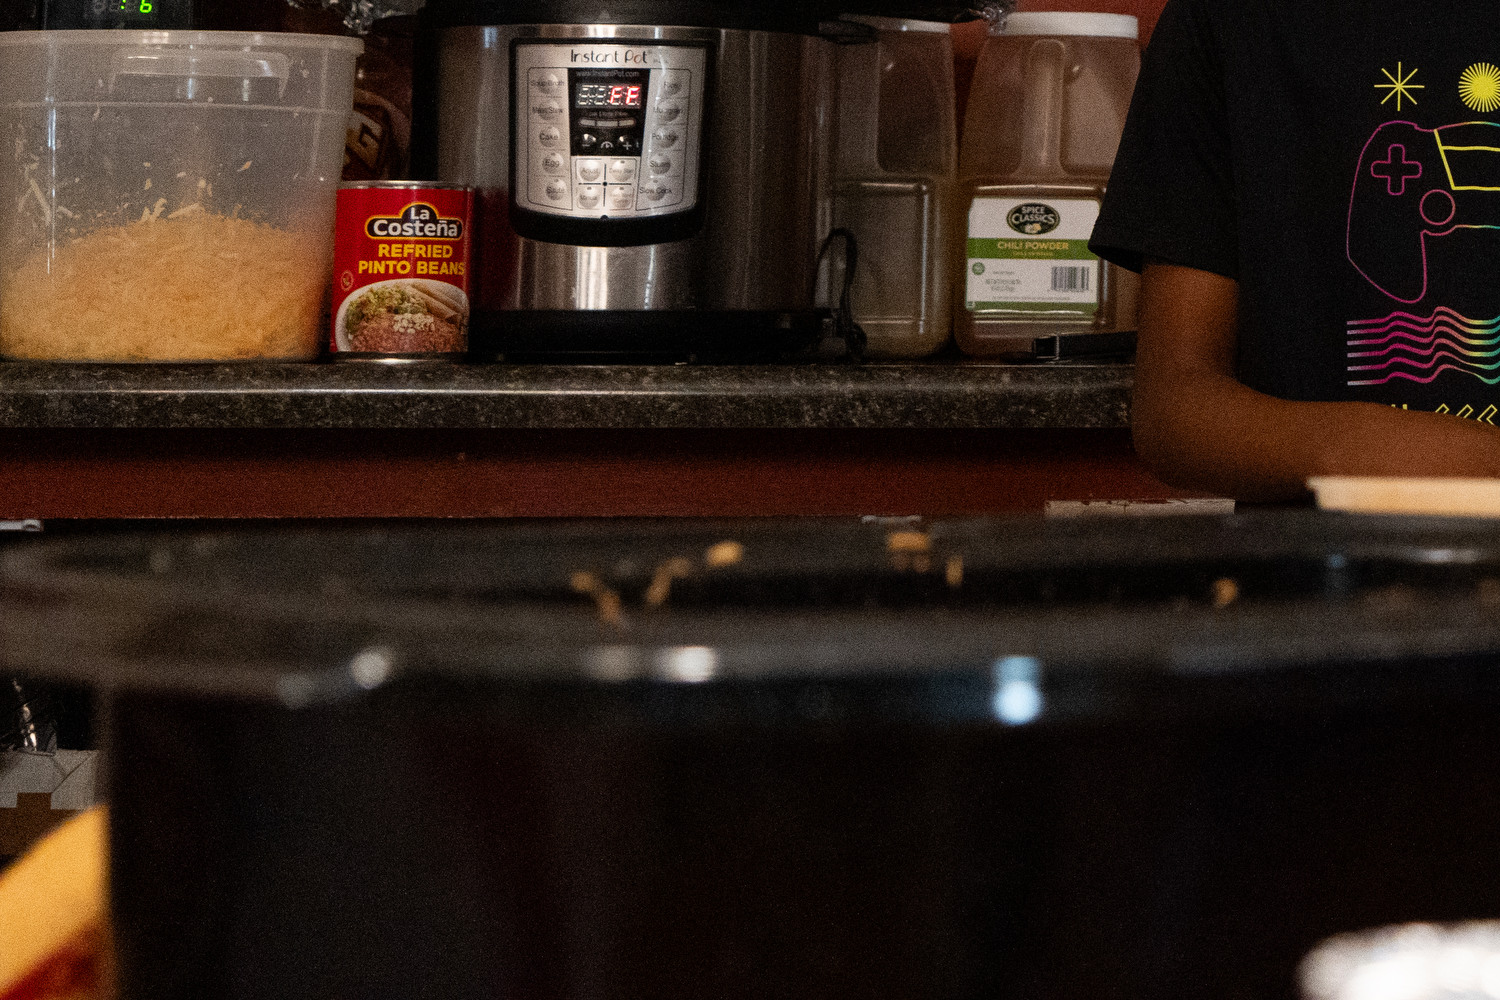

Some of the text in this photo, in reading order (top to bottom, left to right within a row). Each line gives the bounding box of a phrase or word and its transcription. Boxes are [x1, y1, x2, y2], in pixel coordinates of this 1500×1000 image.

[570, 49, 648, 64] Instant Pot
[411, 207, 429, 220] La
[1021, 206, 1045, 214] SPICE
[1012, 213, 1055, 224] CLASSICS
[373, 219, 458, 237] Costeña
[378, 243, 453, 259] REFRIED
[997, 241, 1069, 250] CHILI POWDER
[358, 260, 465, 276] PINTO BEANS
